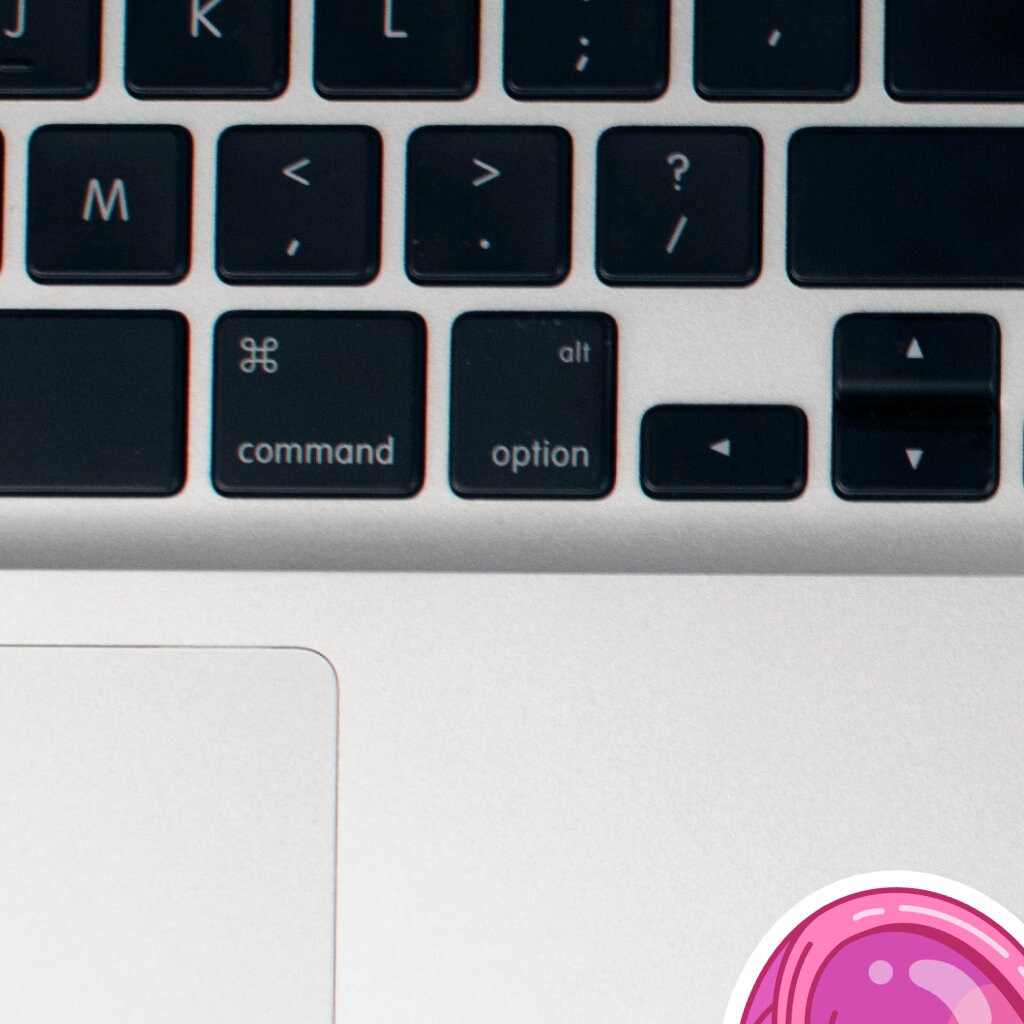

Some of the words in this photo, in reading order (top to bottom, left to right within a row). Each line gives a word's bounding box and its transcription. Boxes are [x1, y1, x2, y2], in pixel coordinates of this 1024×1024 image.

[4, 0, 26, 38] J
[190, 0, 222, 38] K
[383, 0, 408, 38] L
[282, 158, 311, 186] <
[473, 158, 501, 187] >
[666, 153, 690, 191] ?
[82, 178, 129, 221] M
[666, 215, 688, 254] /
[559, 340, 591, 363] alt
[237, 435, 395, 465] command
[491, 439, 589, 473] option
